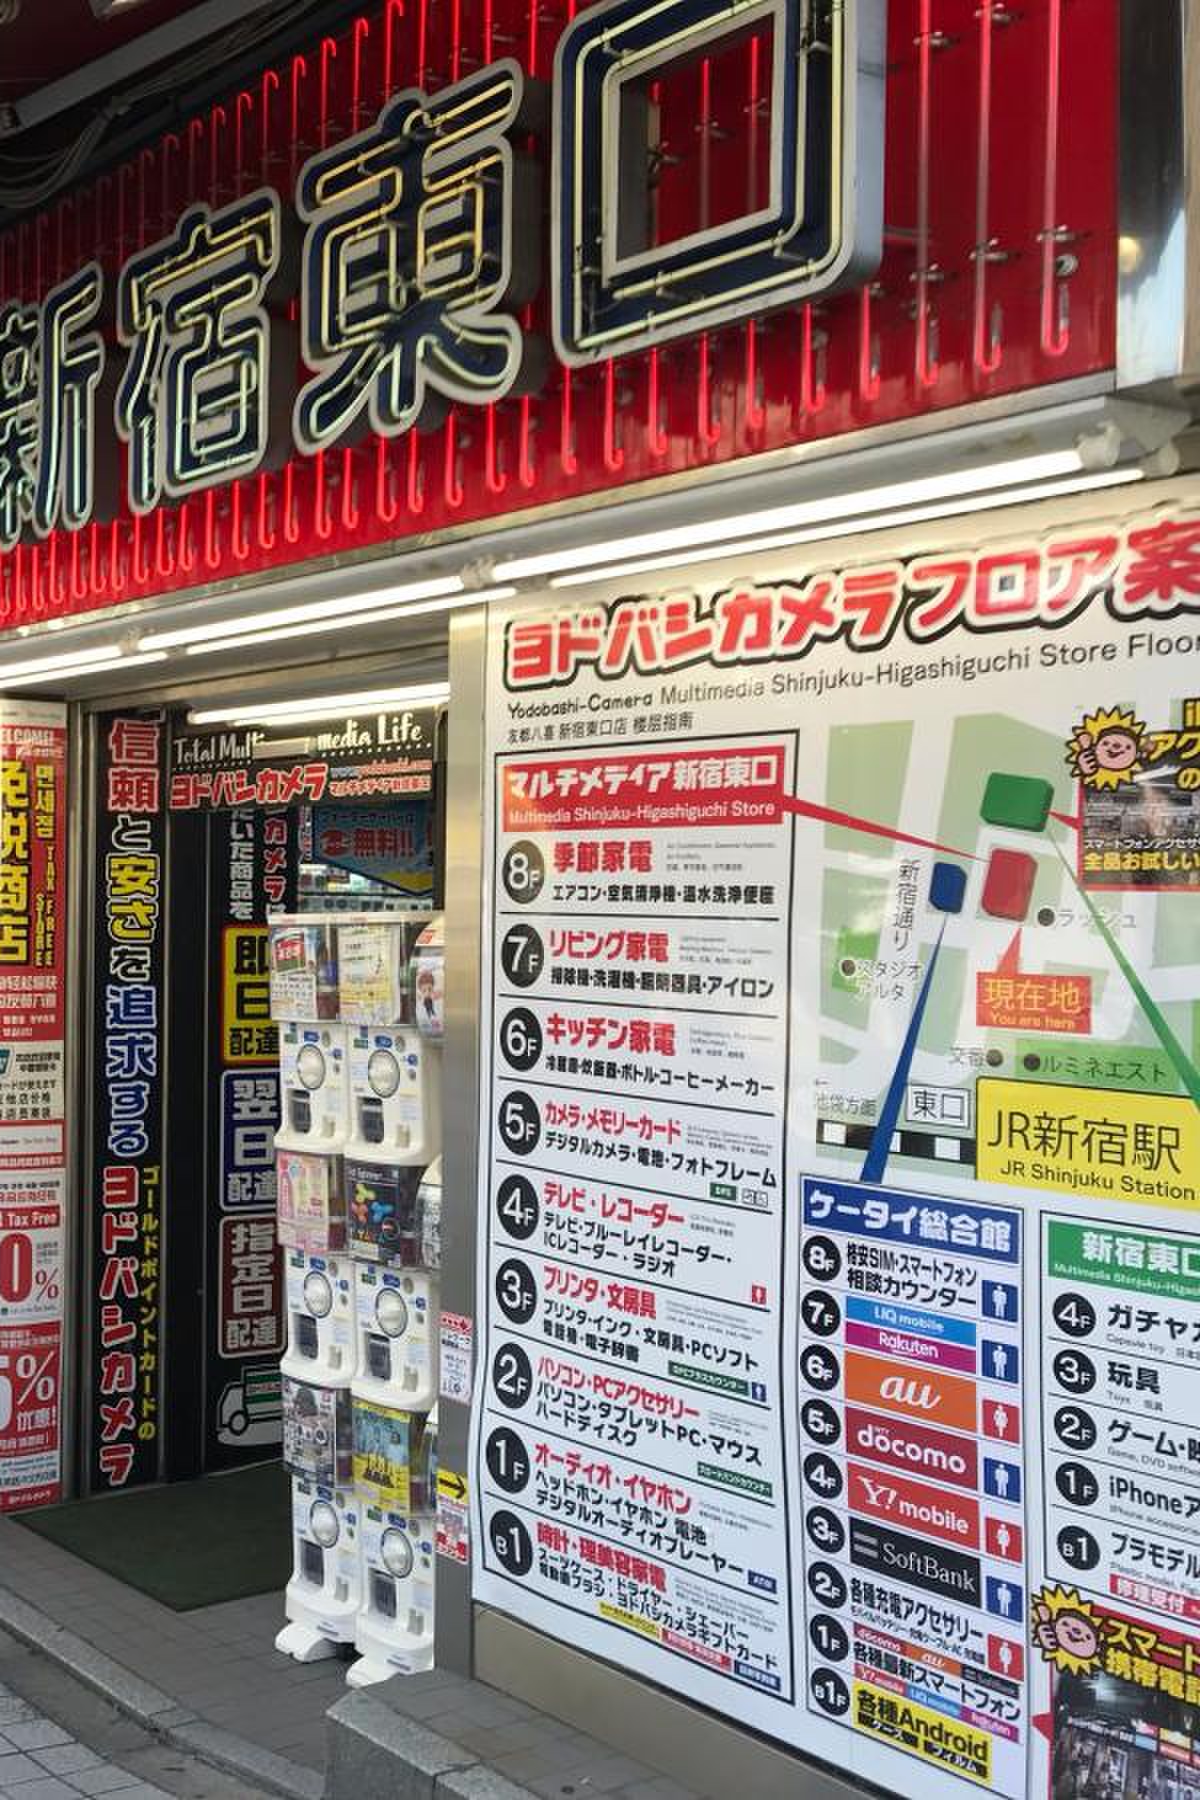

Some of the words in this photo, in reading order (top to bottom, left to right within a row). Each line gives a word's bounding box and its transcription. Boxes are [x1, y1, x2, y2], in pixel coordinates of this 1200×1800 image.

[507, 693, 653, 720] Yodobashi-Camera
[660, 682, 765, 706] Multimedia
[771, 651, 1031, 695] Shinjuku-Higashiguchi
[1038, 641, 1118, 668] Store
[174, 736, 216, 765] Total
[377, 712, 422, 744] Life
[169, 763, 329, 810] ヨドバシカメラ
[507, 754, 778, 799] マルチメディア新宿東口
[574, 800, 727, 822] Shinjuku-Higashiguchi
[731, 801, 776, 818] Store
[504, 852, 541, 890] 8F
[553, 840, 653, 873] 季節家電
[104, 719, 160, 1158] 信頼と安さを追求する
[506, 935, 539, 974] 7F
[550, 929, 669, 963] リビング家電
[983, 977, 1084, 1015] 現在地
[505, 1019, 538, 1056] 6F
[546, 1013, 676, 1057] キッチン家電
[990, 1012, 1014, 1026] You
[1016, 1015, 1040, 1028] are
[1043, 1056, 1167, 1084] ルミネエスト
[505, 1103, 536, 1140] 5F
[545, 1101, 682, 1145] カメラ・メモリーカード
[912, 1091, 966, 1120] 東口
[987, 1110, 1182, 1174] JR新宿駅
[1000, 1160, 1025, 1177] JR
[1031, 1163, 1114, 1190] Shinjuku
[1120, 1176, 1195, 1201] Station
[8, 1213, 30, 1227] Tax
[502, 1187, 535, 1228] 4F
[543, 1181, 685, 1229] テレビ・レコーダー
[809, 1188, 1012, 1253] ケータイ総合館
[231, 1223, 275, 1313] 指定日
[809, 1246, 834, 1272] 8F
[138, 1166, 161, 1441] ゴールドポイントカードの
[501, 1269, 534, 1312] 3F
[543, 1265, 657, 1320] プリンタ・文房具
[847, 1268, 977, 1308] 相談カウンター
[99, 1165, 140, 1487] ヨドバシカメラ
[226, 1318, 278, 1349] 配達
[807, 1301, 834, 1328] 7F
[1058, 1301, 1092, 1330] 4F
[879, 1331, 939, 1358] Rakuten
[498, 1353, 528, 1395] 2F
[1059, 1356, 1092, 1385] 3F
[1107, 1361, 1161, 1395] 玩具
[879, 1376, 942, 1410] au
[535, 1400, 637, 1447] ハードディスク
[807, 1410, 834, 1436] 5F
[1060, 1413, 1093, 1441] 2F
[495, 1439, 525, 1481] 1F
[857, 1424, 967, 1474] docomo
[810, 1464, 836, 1489] 4F
[1064, 1469, 1096, 1499] 1F
[812, 1516, 838, 1544] 3F
[899, 1498, 970, 1535] mobile
[496, 1526, 522, 1564] B1
[1111, 1531, 1200, 1579] プラモデル
[815, 1571, 841, 1599] 2F
[882, 1542, 977, 1594] SoftBank
[816, 1625, 841, 1651] 1F
[856, 1688, 988, 1763] 各種Android
